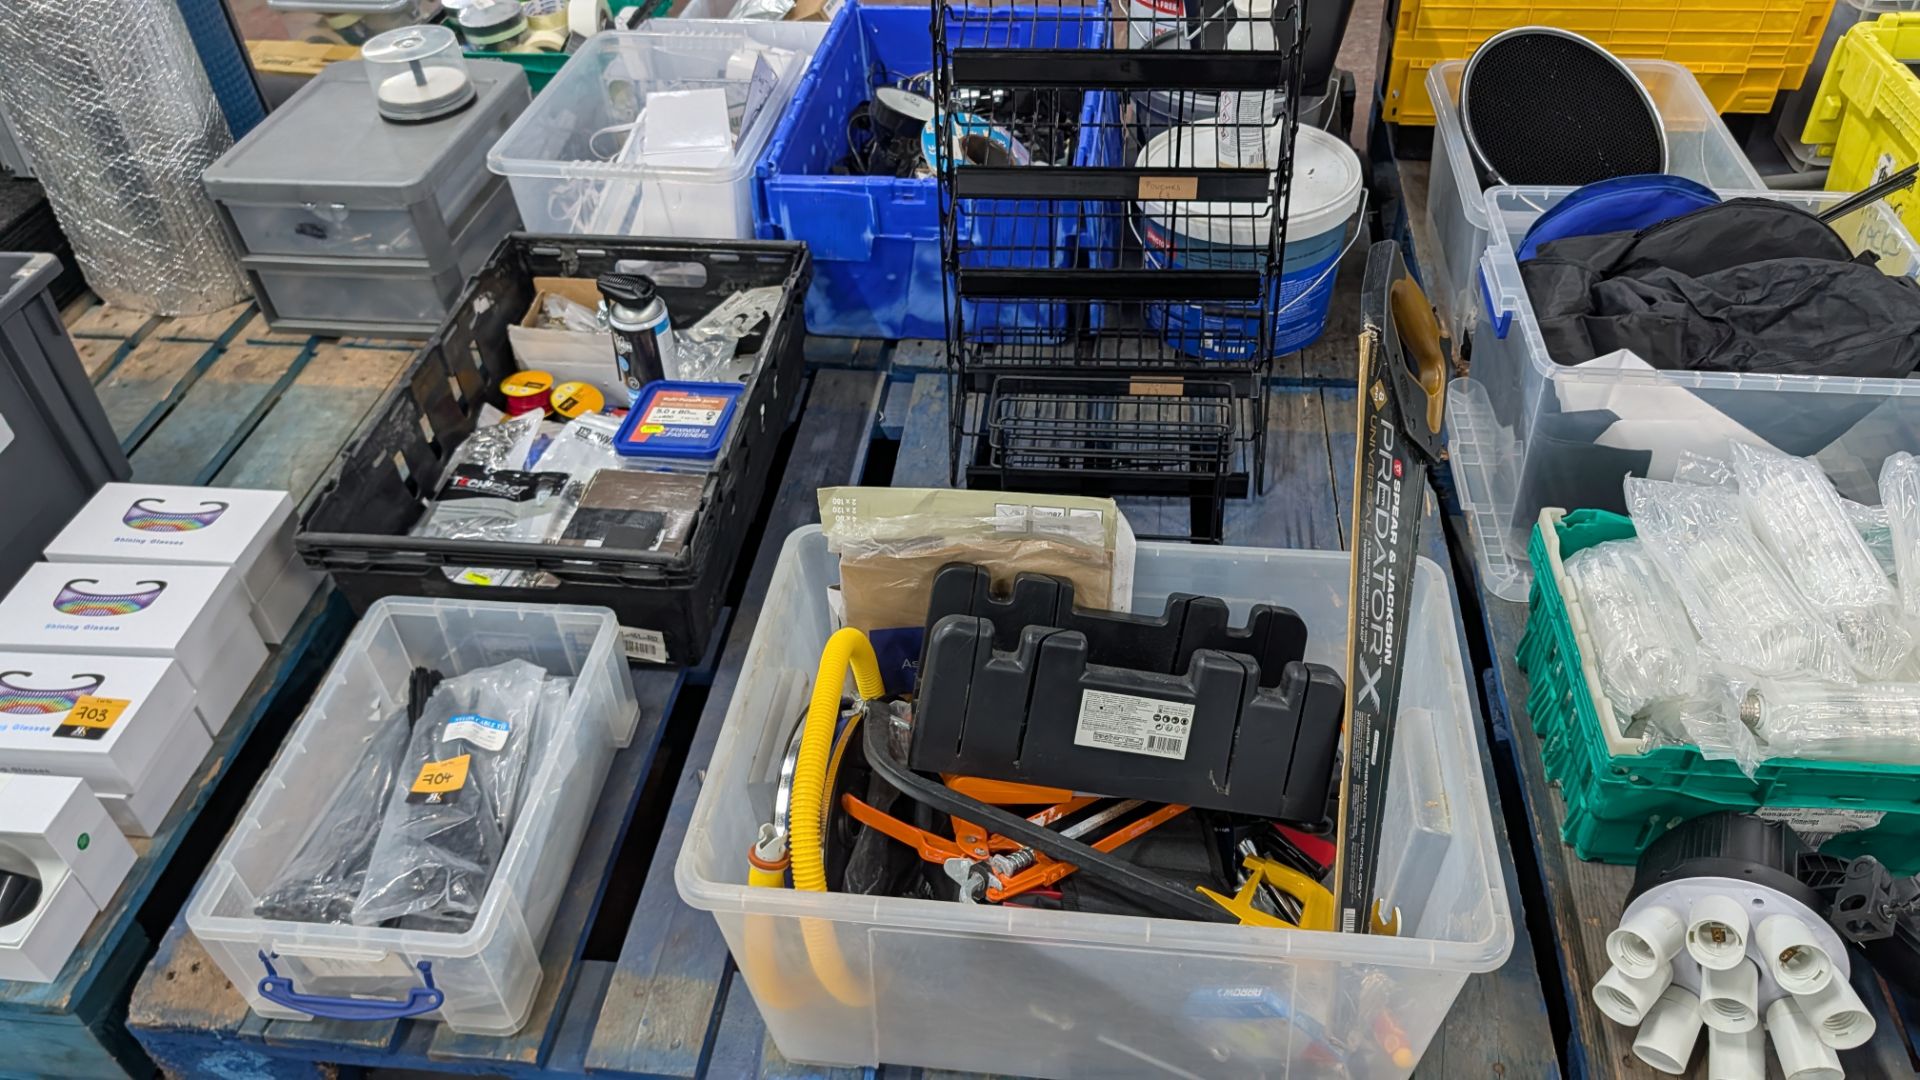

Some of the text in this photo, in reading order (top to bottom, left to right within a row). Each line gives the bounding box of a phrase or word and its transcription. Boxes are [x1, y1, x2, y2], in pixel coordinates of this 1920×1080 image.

[1364, 414, 1378, 531] UNIVERSAL
[114, 537, 185, 546] Shining Glasses
[1370, 418, 1395, 662] PREDATOR
[1382, 478, 1401, 666] SPEAR & JACKSON
[45, 623, 79, 631] Shining
[902, 657, 920, 669] As
[75, 706, 108, 722] 703
[12, 723, 51, 731] Glasses
[422, 772, 454, 785] 704
[1357, 821, 1367, 899] TECHNOLOGY
[1224, 987, 1263, 997] ARROW
